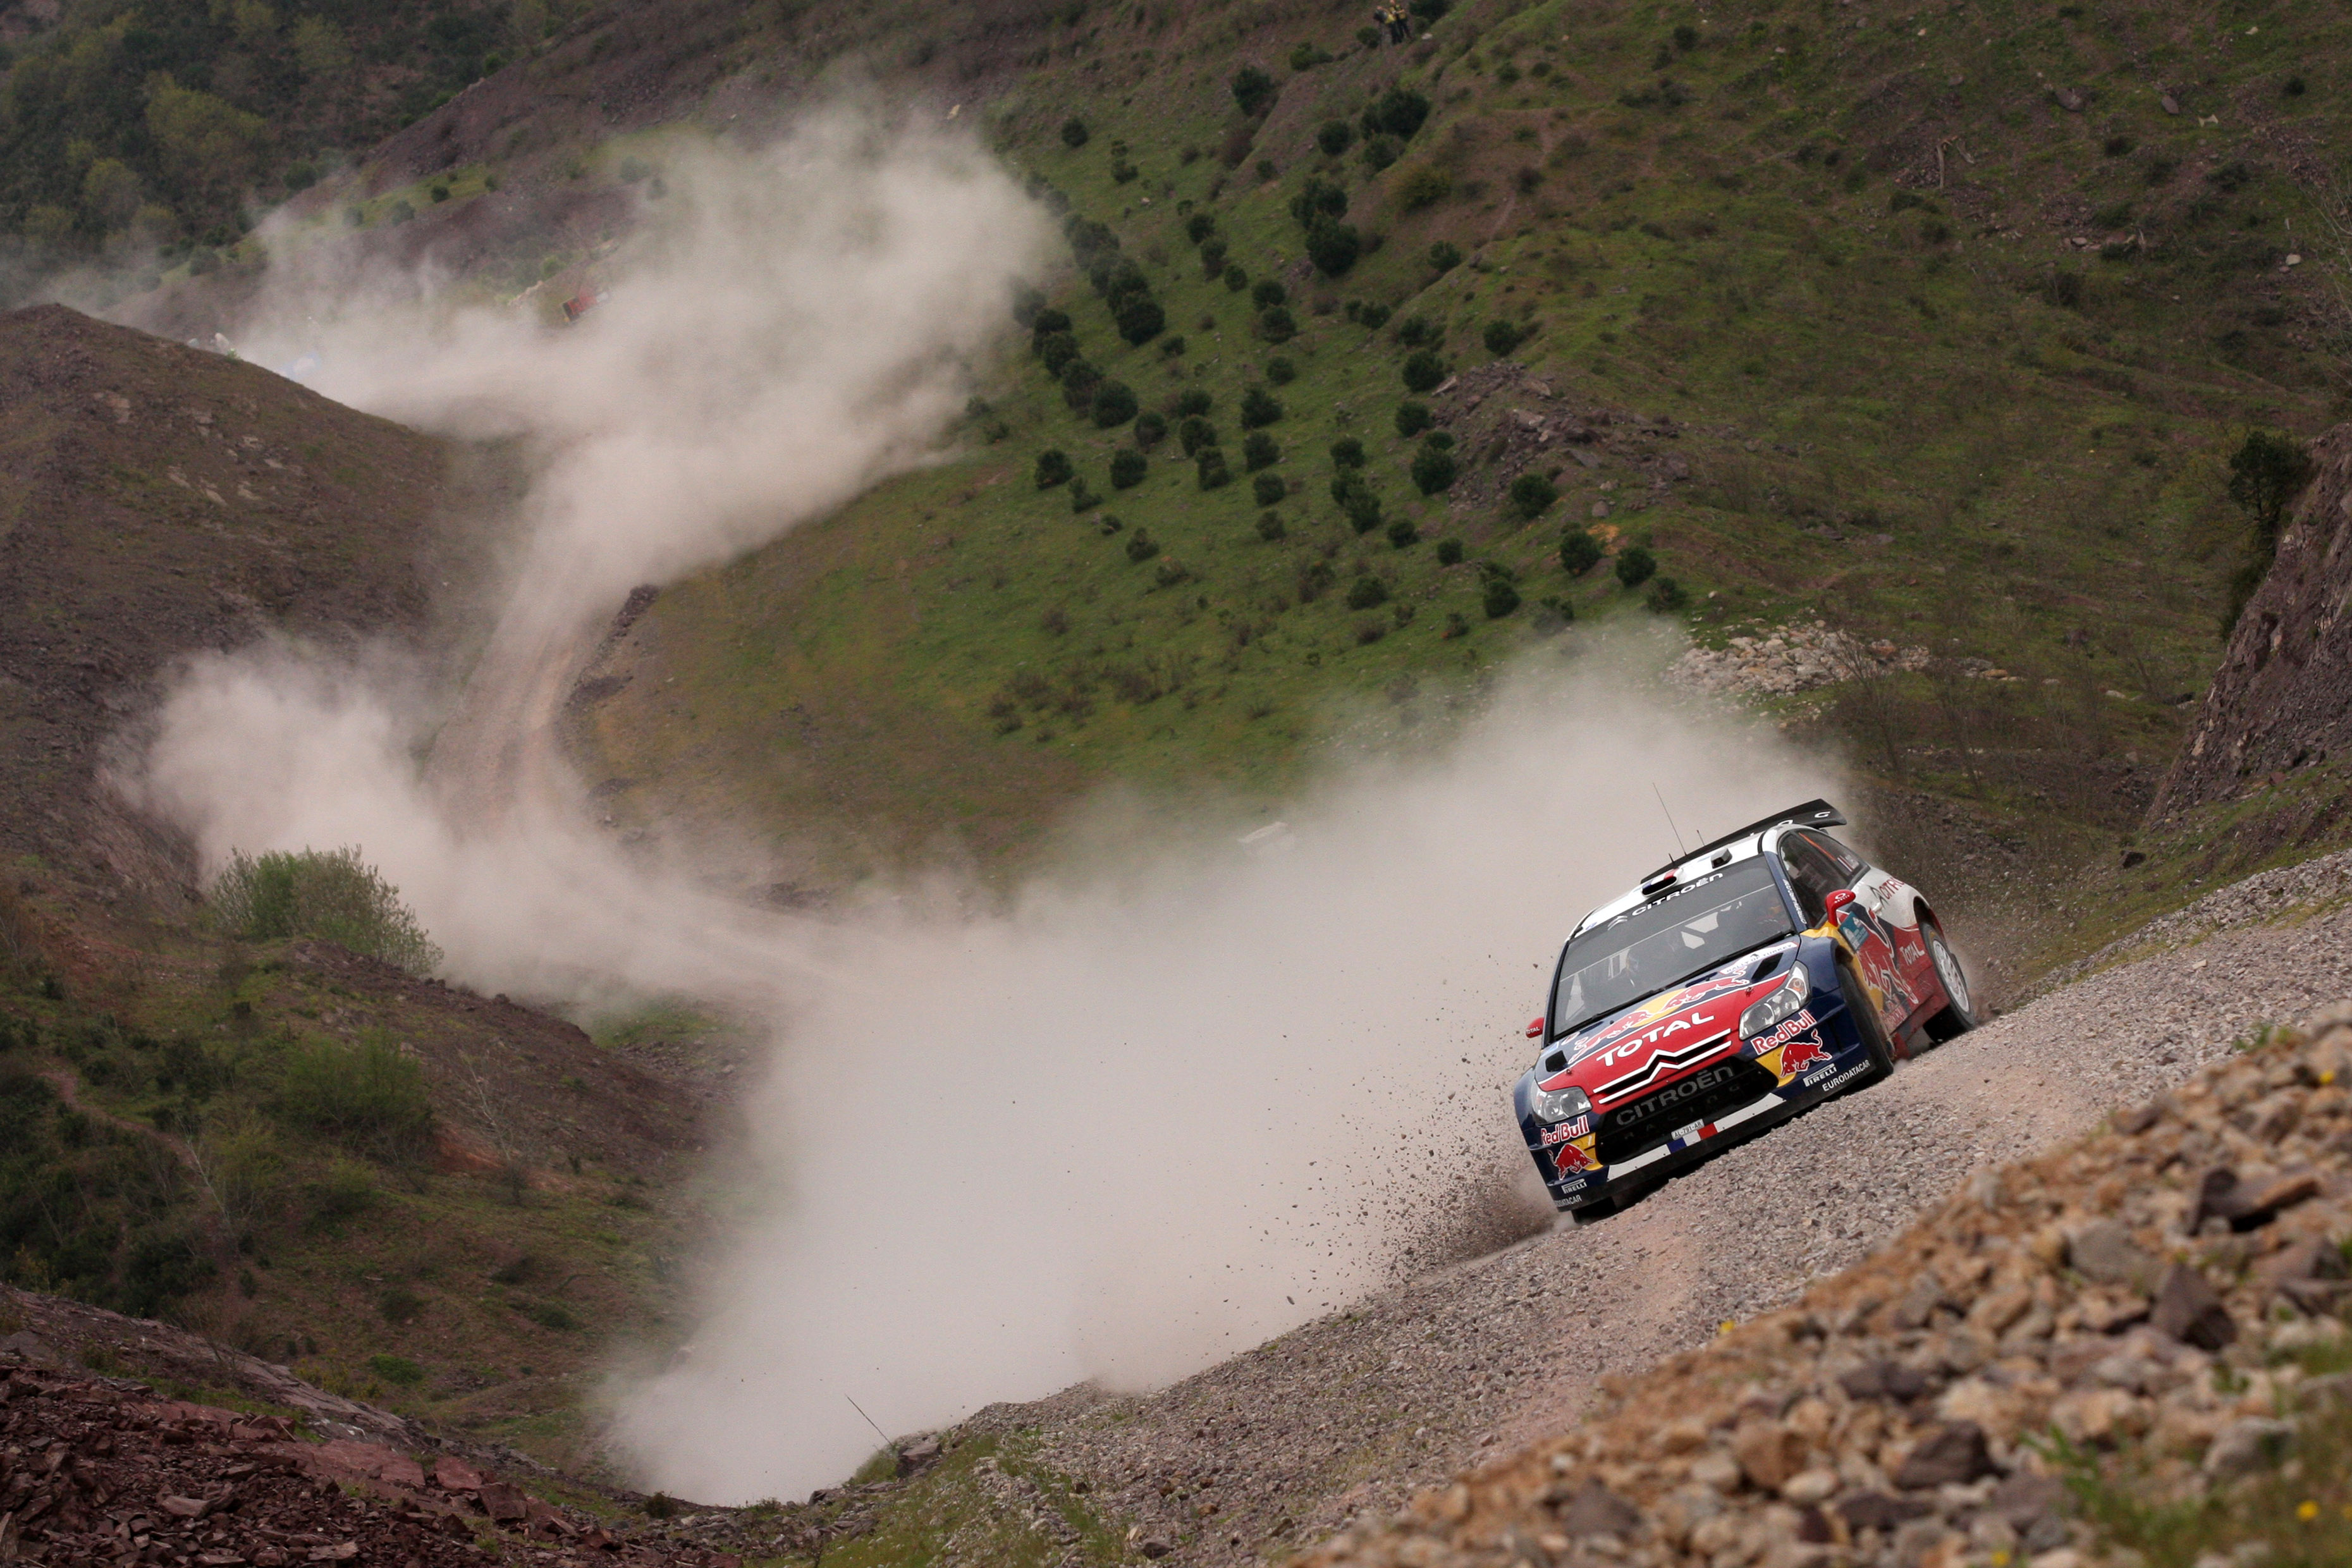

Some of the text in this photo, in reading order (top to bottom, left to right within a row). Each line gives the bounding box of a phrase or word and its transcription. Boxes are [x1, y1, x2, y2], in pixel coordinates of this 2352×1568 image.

[1899, 940, 1925, 966] TOTAL
[1595, 1012, 1715, 1067] TOTAL
[1803, 1063, 1837, 1087] PIRELLI
[1822, 1059, 1871, 1092] EURODATACAR
[1561, 1178, 1588, 1194] PIRELLI
